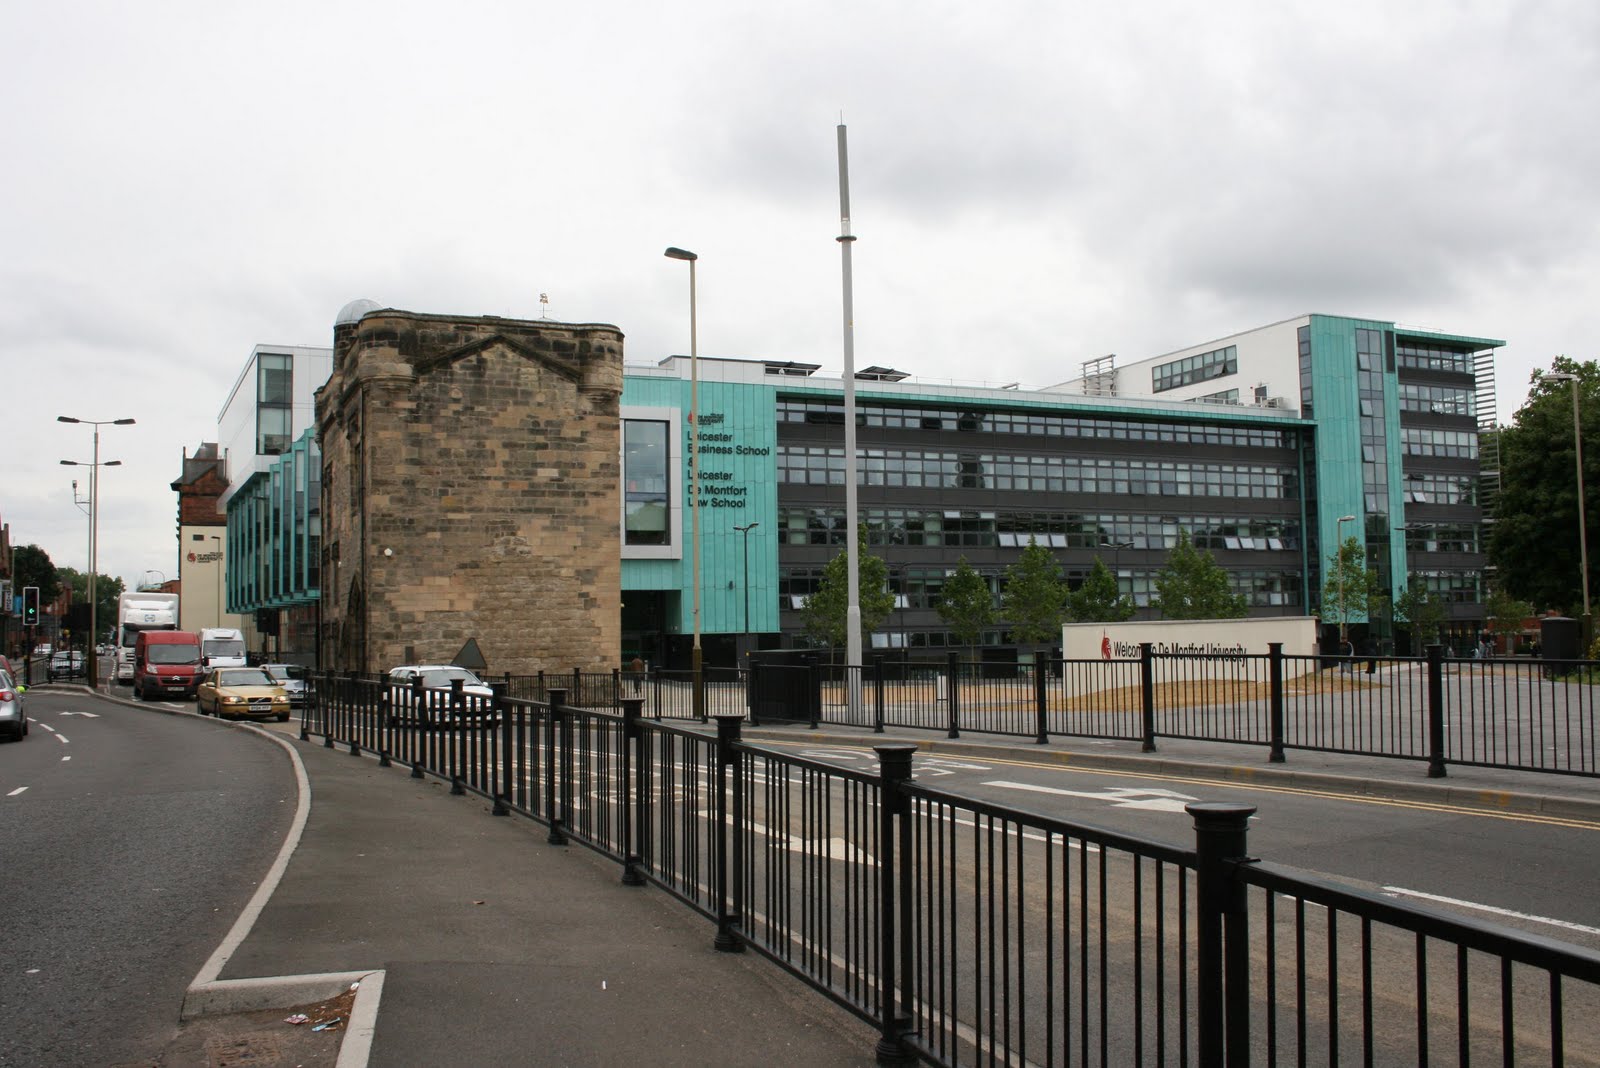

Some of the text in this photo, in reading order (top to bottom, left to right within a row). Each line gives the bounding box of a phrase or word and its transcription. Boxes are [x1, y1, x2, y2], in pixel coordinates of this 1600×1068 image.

[736, 445, 770, 456] School
[704, 484, 747, 496] Montfort
[711, 498, 746, 509] School
[1113, 641, 1142, 658] Welcom
[1158, 642, 1170, 660] De
[1171, 642, 1204, 661] Montfort
[1206, 643, 1247, 668] University
